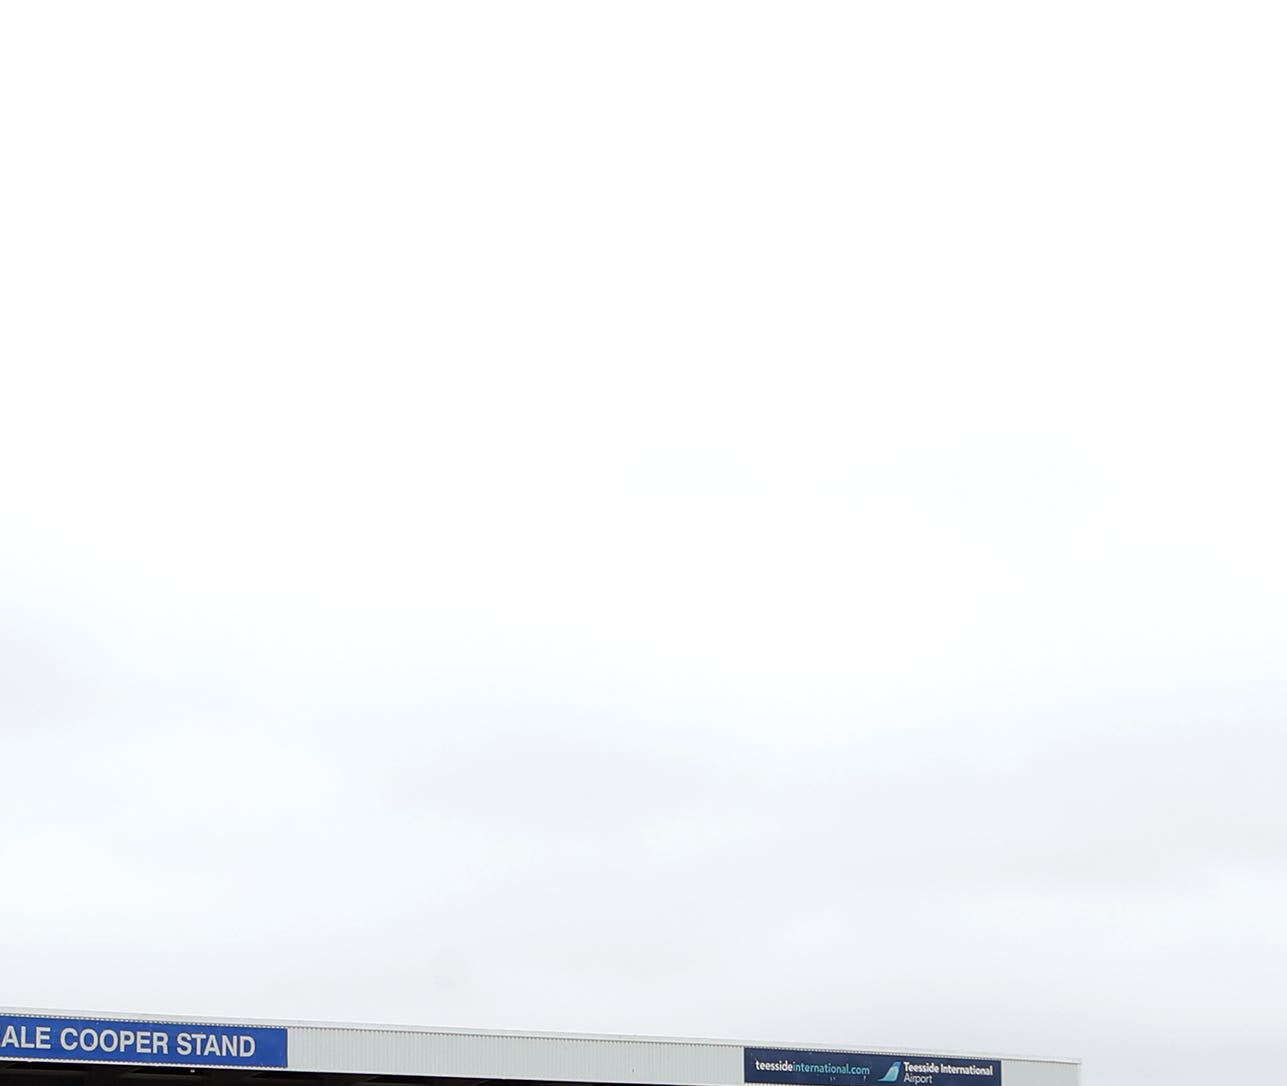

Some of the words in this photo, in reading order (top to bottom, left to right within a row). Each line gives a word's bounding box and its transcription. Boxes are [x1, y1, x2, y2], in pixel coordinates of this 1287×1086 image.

[60, 1027, 168, 1054] COOPER
[176, 1032, 255, 1058] STAND
[755, 1058, 870, 1076] teessideinternational.com
[903, 1061, 940, 1073] Teesside
[940, 1063, 993, 1076] International
[903, 1074, 934, 1085] Airport
